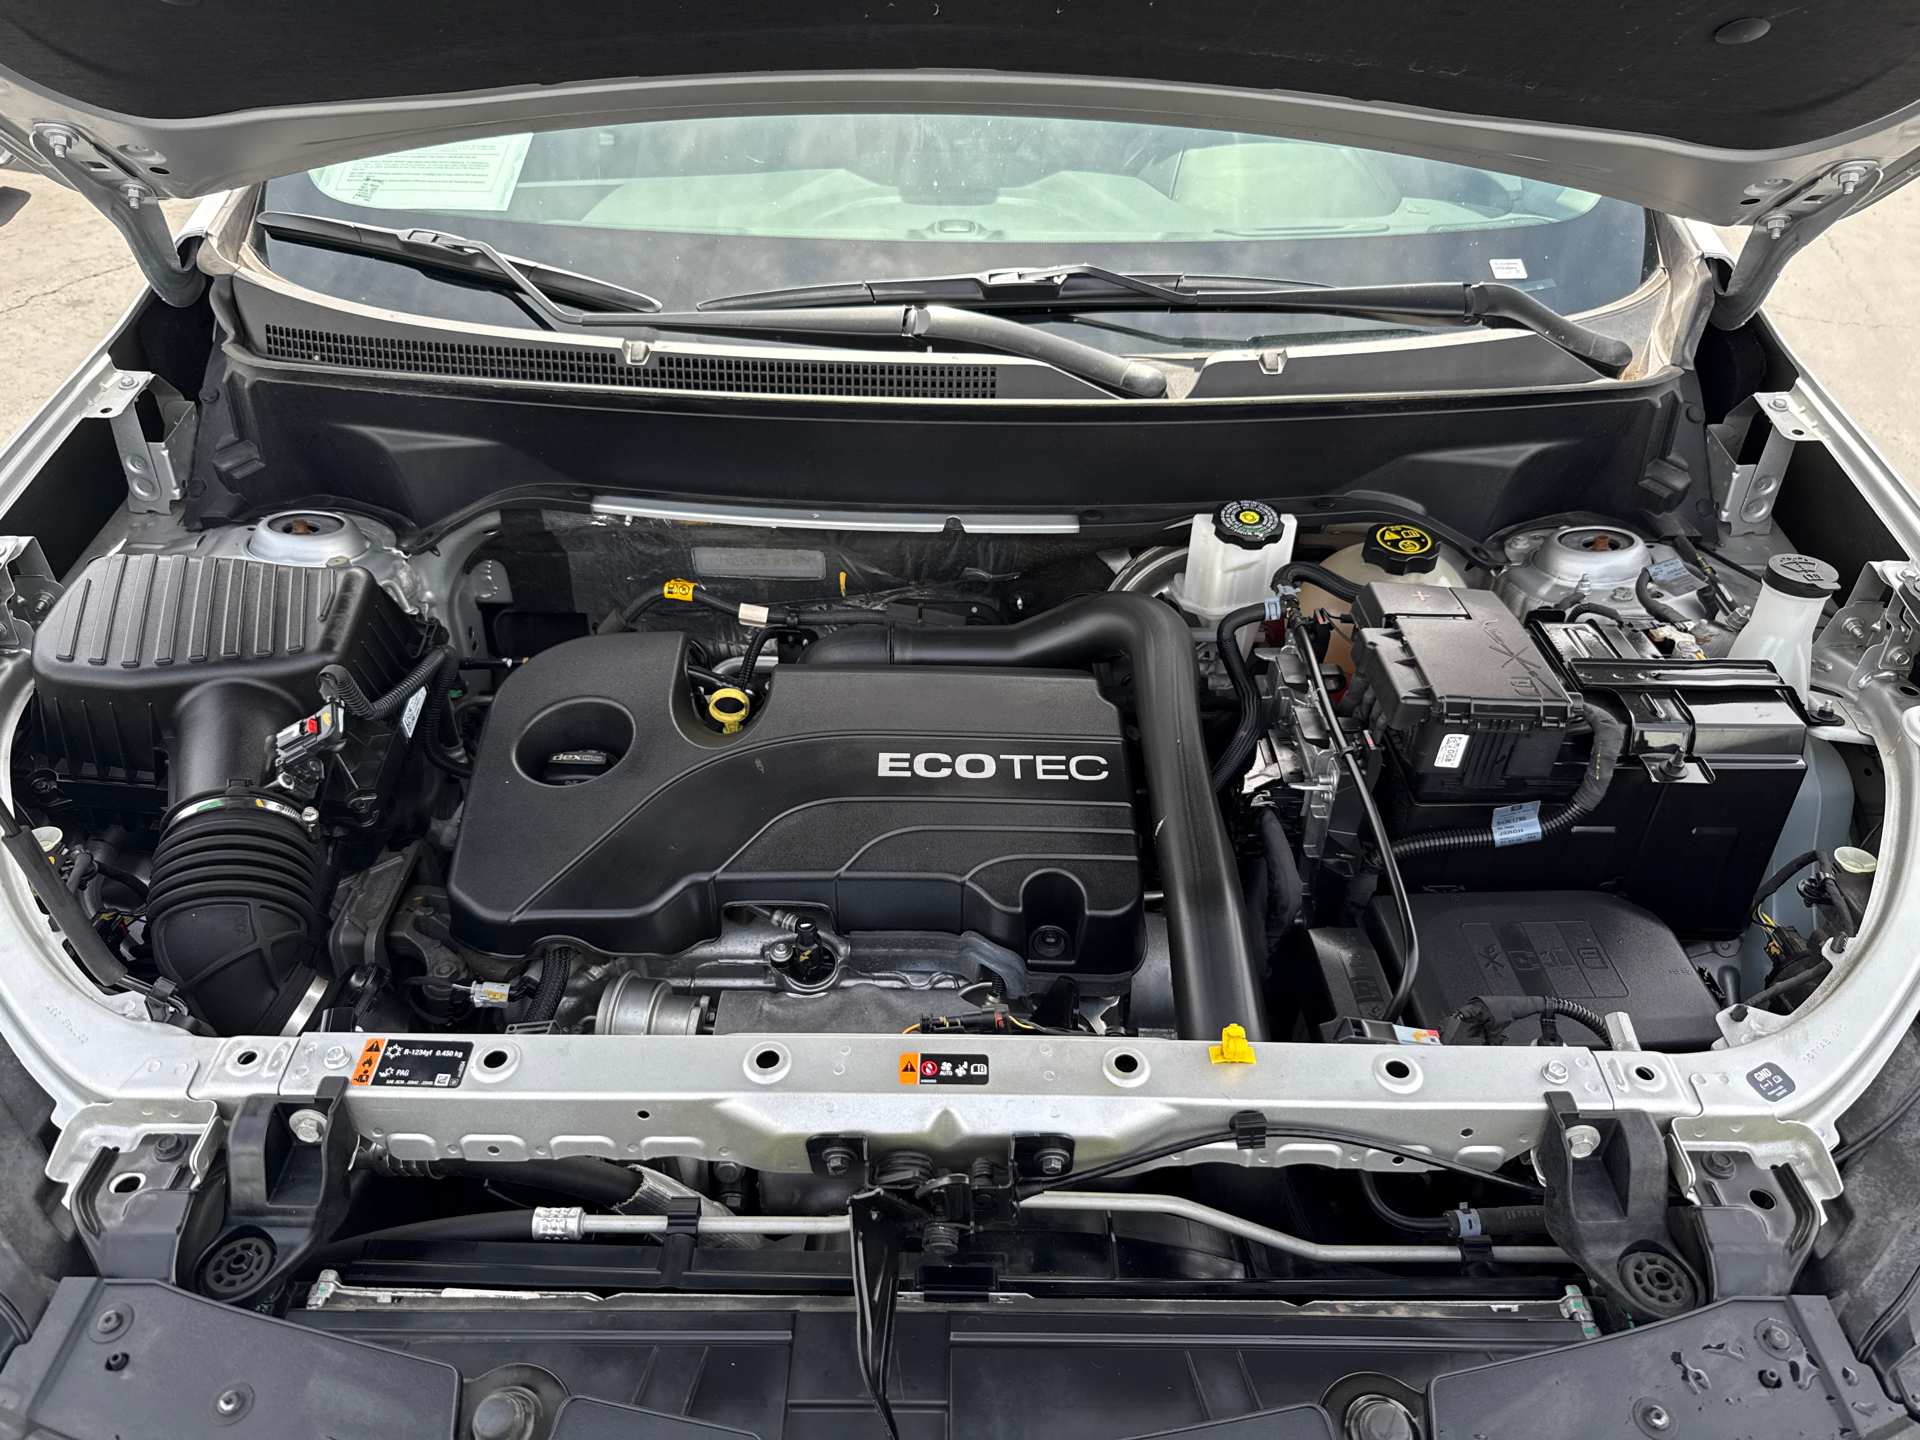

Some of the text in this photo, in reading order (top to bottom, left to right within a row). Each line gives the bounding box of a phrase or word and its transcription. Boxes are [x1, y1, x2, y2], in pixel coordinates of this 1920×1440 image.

[552, 753, 603, 762] dexos
[878, 752, 1109, 781] ECOTEC
[403, 1048, 463, 1058] R-1234yf 0.450 kg
[395, 1069, 410, 1077] PAG
[1753, 1067, 1772, 1082] GND
